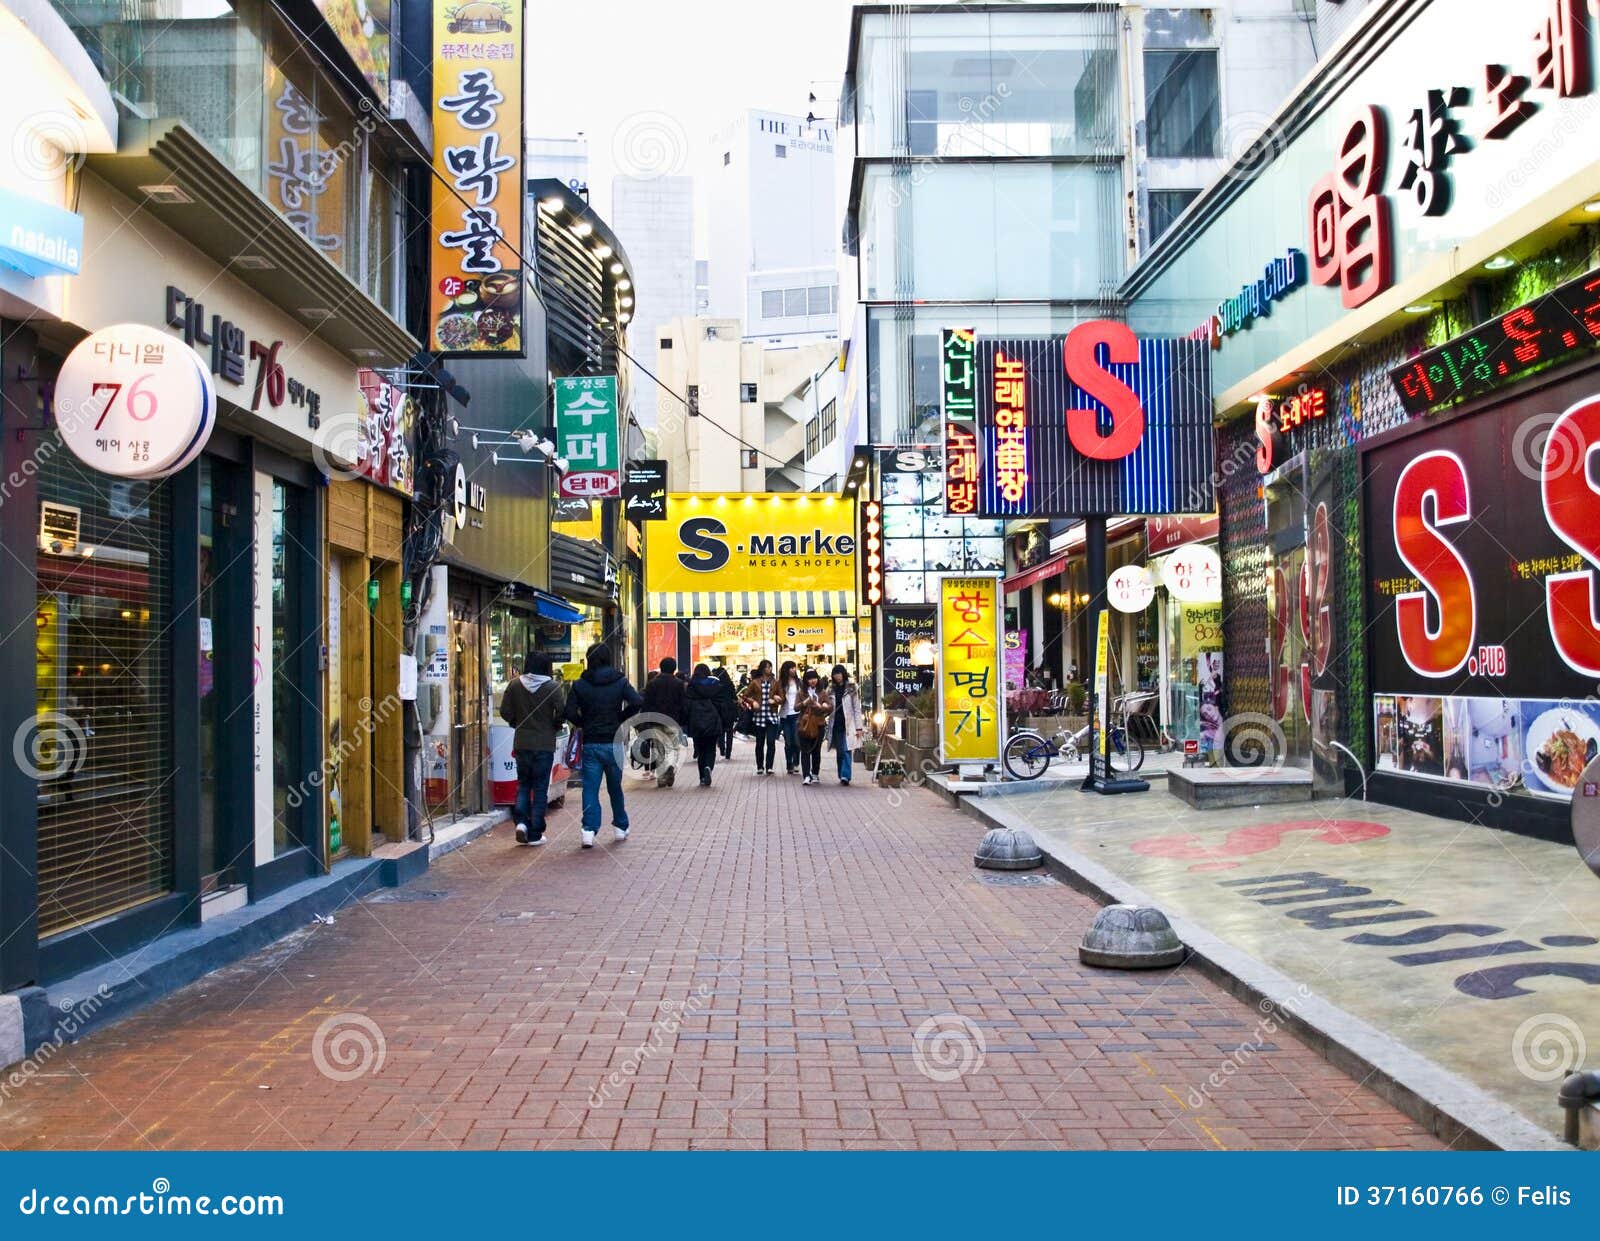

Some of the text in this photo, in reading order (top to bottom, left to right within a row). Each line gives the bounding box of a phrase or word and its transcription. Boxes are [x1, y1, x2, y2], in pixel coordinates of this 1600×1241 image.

[440, 70, 515, 274] 동막골
[10, 226, 79, 267] natalia
[444, 278, 462, 297] 2F
[1216, 284, 1262, 337] Singing
[1263, 250, 1300, 301] Club
[94, 342, 166, 366] 다니엘
[166, 285, 246, 386] 다니엘
[249, 340, 284, 411] 76
[944, 333, 975, 421] 신나는
[91, 373, 159, 431] 76
[564, 378, 608, 389] 동성로
[1064, 320, 1144, 461] S
[96, 439, 152, 462] 헤어 살롱
[564, 391, 610, 467] 수퍼
[994, 350, 1028, 502] 노래연습장
[1255, 397, 1273, 473] S
[569, 476, 609, 490] 담배
[896, 451, 926, 471] S
[945, 423, 977, 513] 노래방
[749, 559, 851, 567] MEGA SHOEPL
[1173, 562, 1217, 588] 향수
[787, 627, 796, 637] S
[948, 590, 991, 739] 향수명가
[1217, 871, 1600, 1001] music
